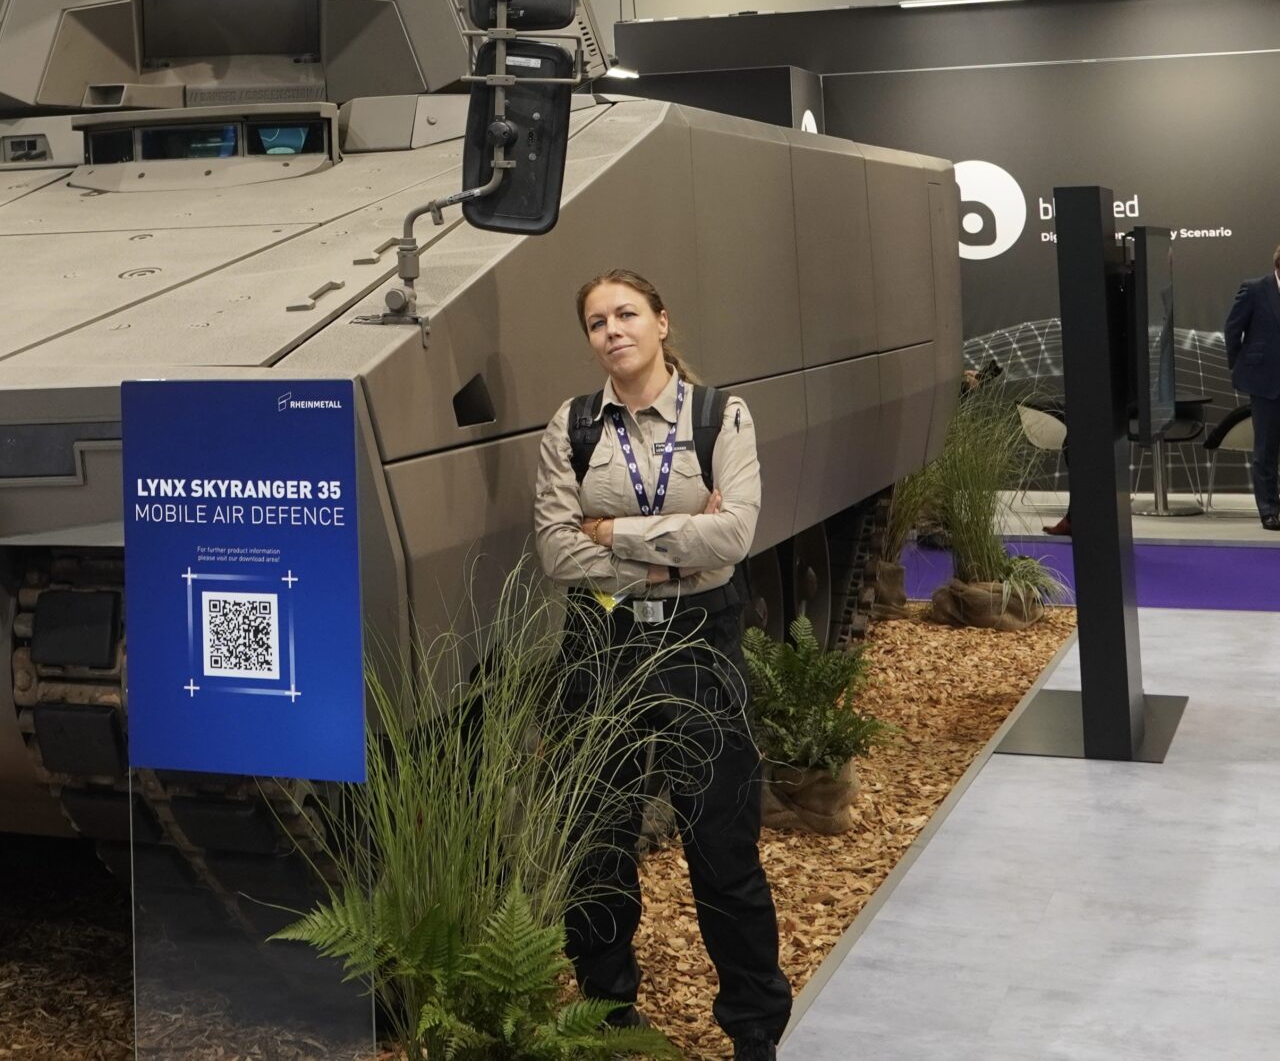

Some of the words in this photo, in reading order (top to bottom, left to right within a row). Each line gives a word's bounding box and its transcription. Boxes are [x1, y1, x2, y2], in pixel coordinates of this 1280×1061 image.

[1179, 226, 1233, 239] Scenario
[290, 400, 342, 409] RHEINMETALL
[137, 478, 187, 497] LYNX
[190, 479, 313, 499] SKYRANGER
[317, 481, 341, 499] 35
[135, 504, 208, 524] MOBILE
[212, 505, 244, 524] AIR
[251, 506, 345, 526] DEFENCE
